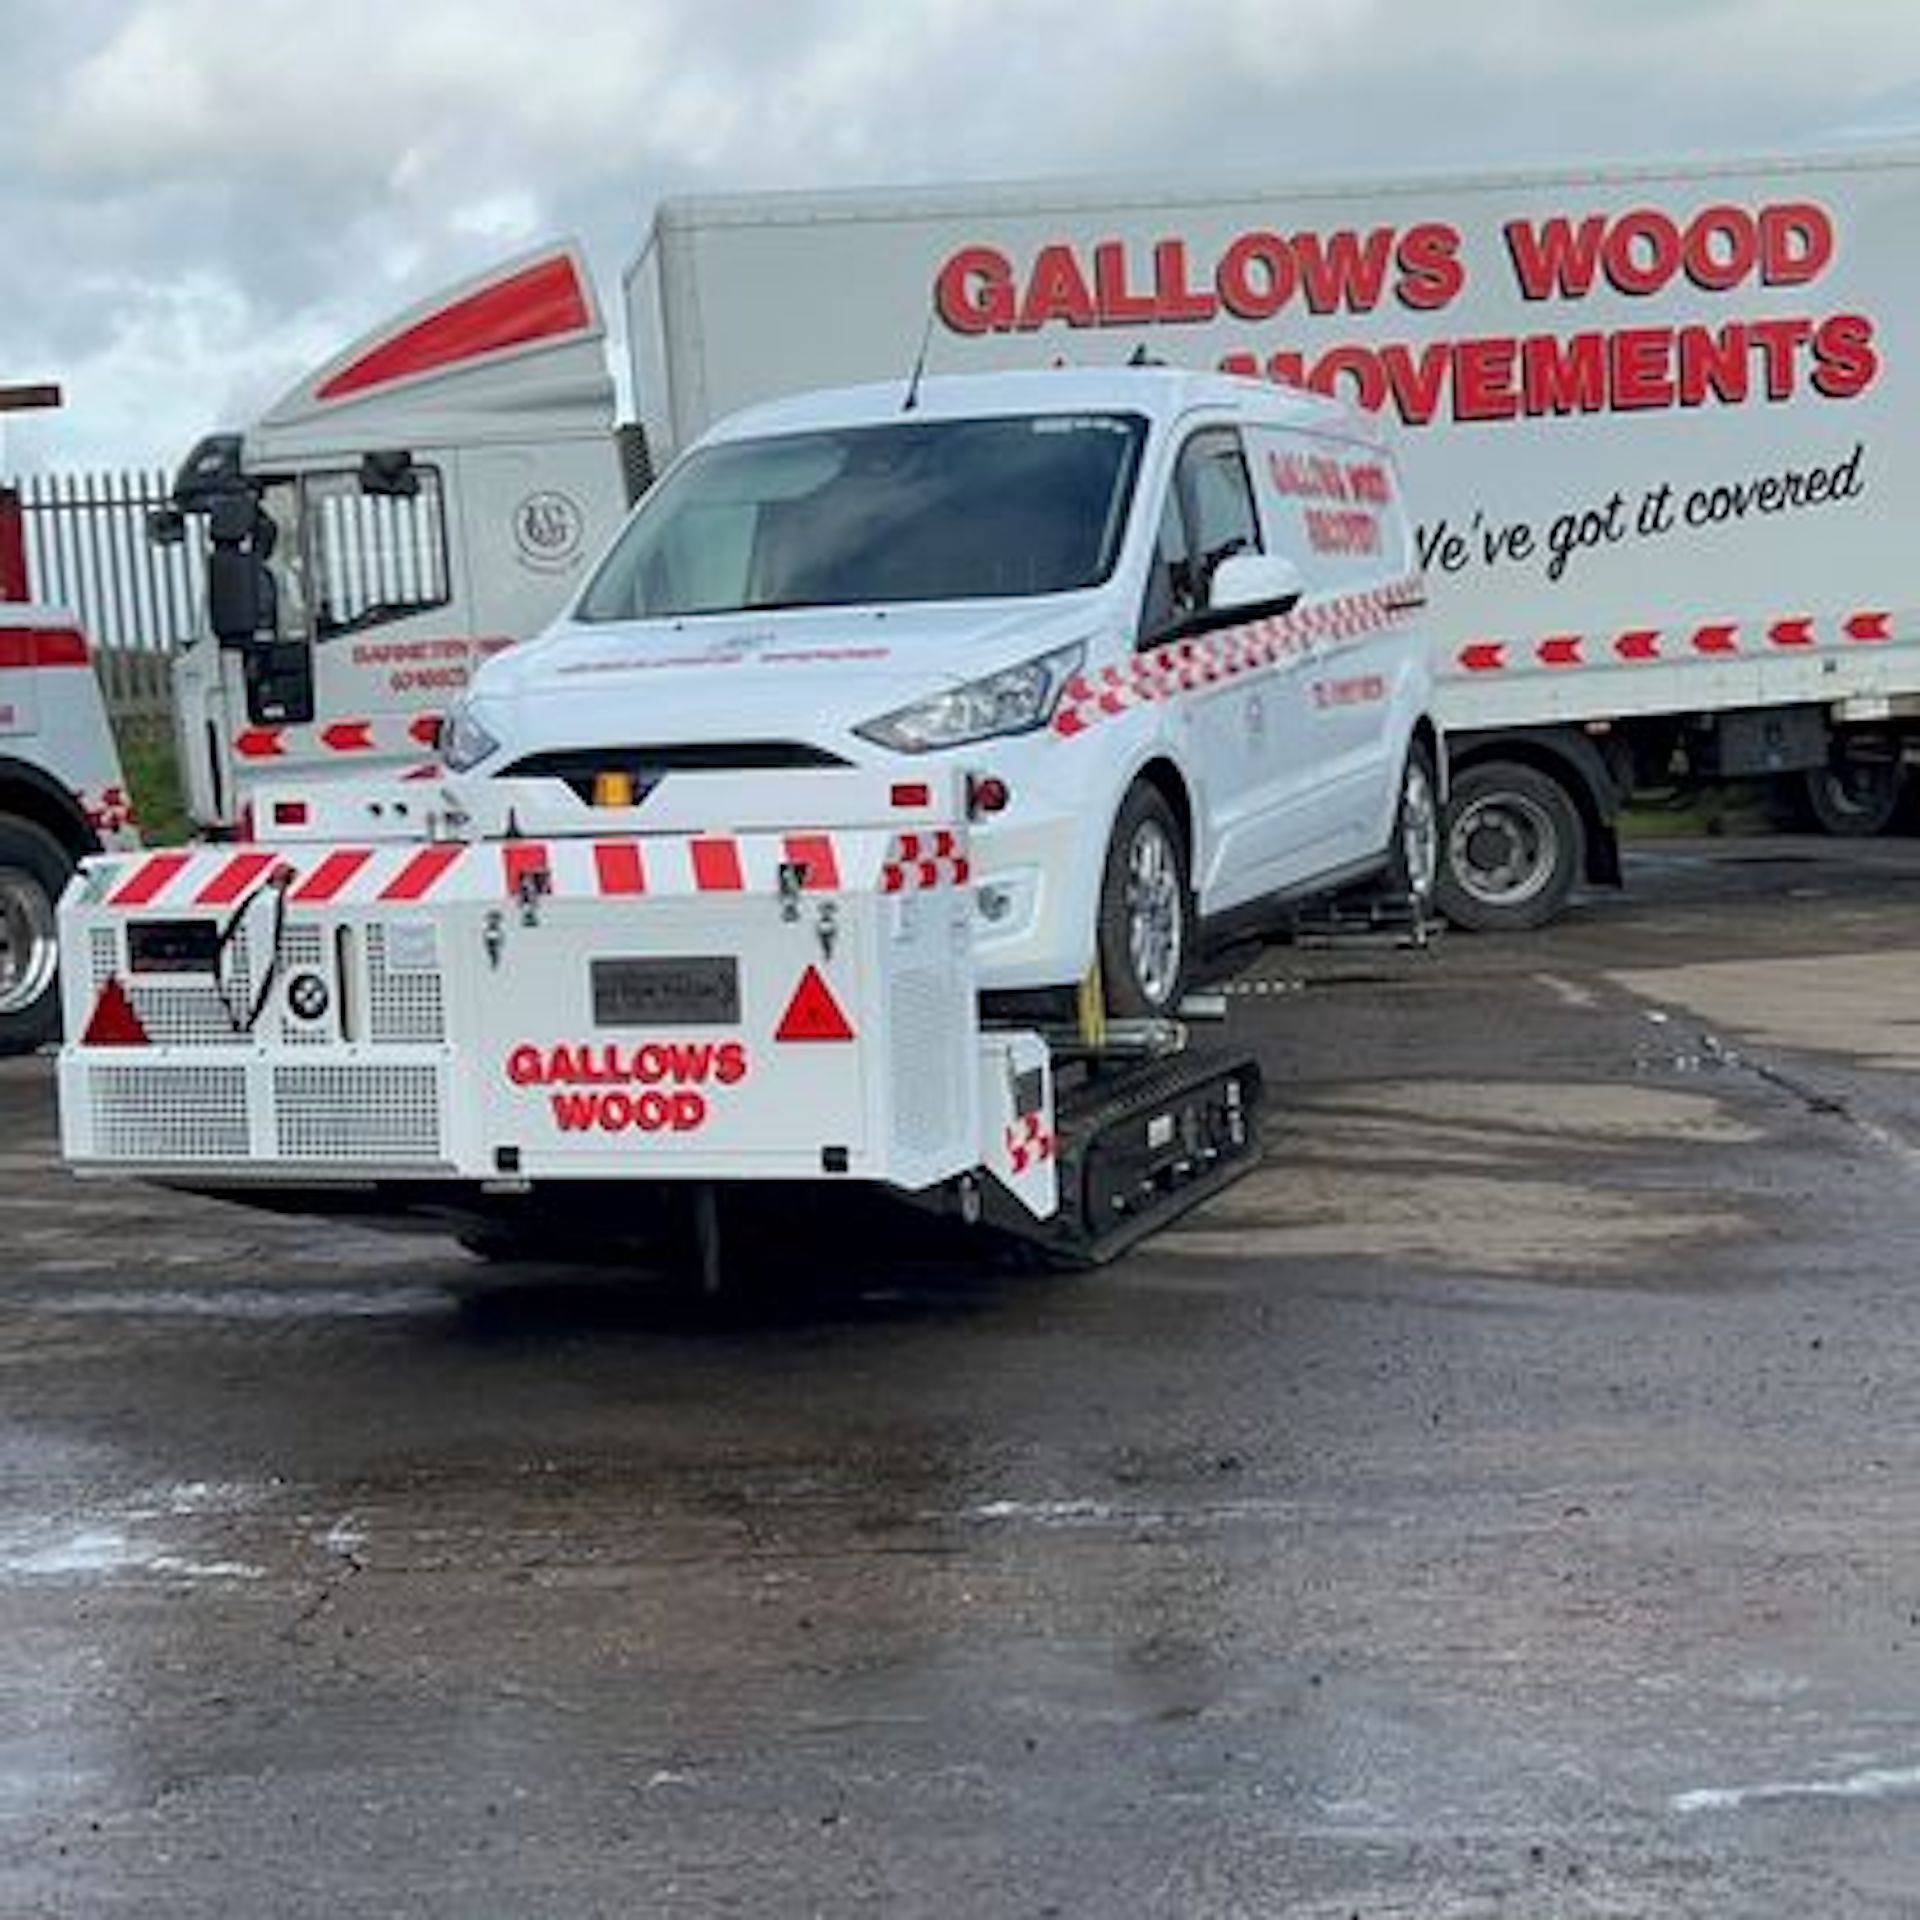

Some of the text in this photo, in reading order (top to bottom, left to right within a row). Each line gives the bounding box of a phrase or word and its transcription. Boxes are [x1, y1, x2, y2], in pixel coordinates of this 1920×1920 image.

[934, 203, 1836, 334] GALLOWS WOOD
[1546, 493, 1627, 581] got
[1636, 482, 1675, 536] it
[1683, 442, 1867, 526] covered
[507, 1043, 748, 1086] GALLOWS
[551, 1091, 707, 1131] WOOD
